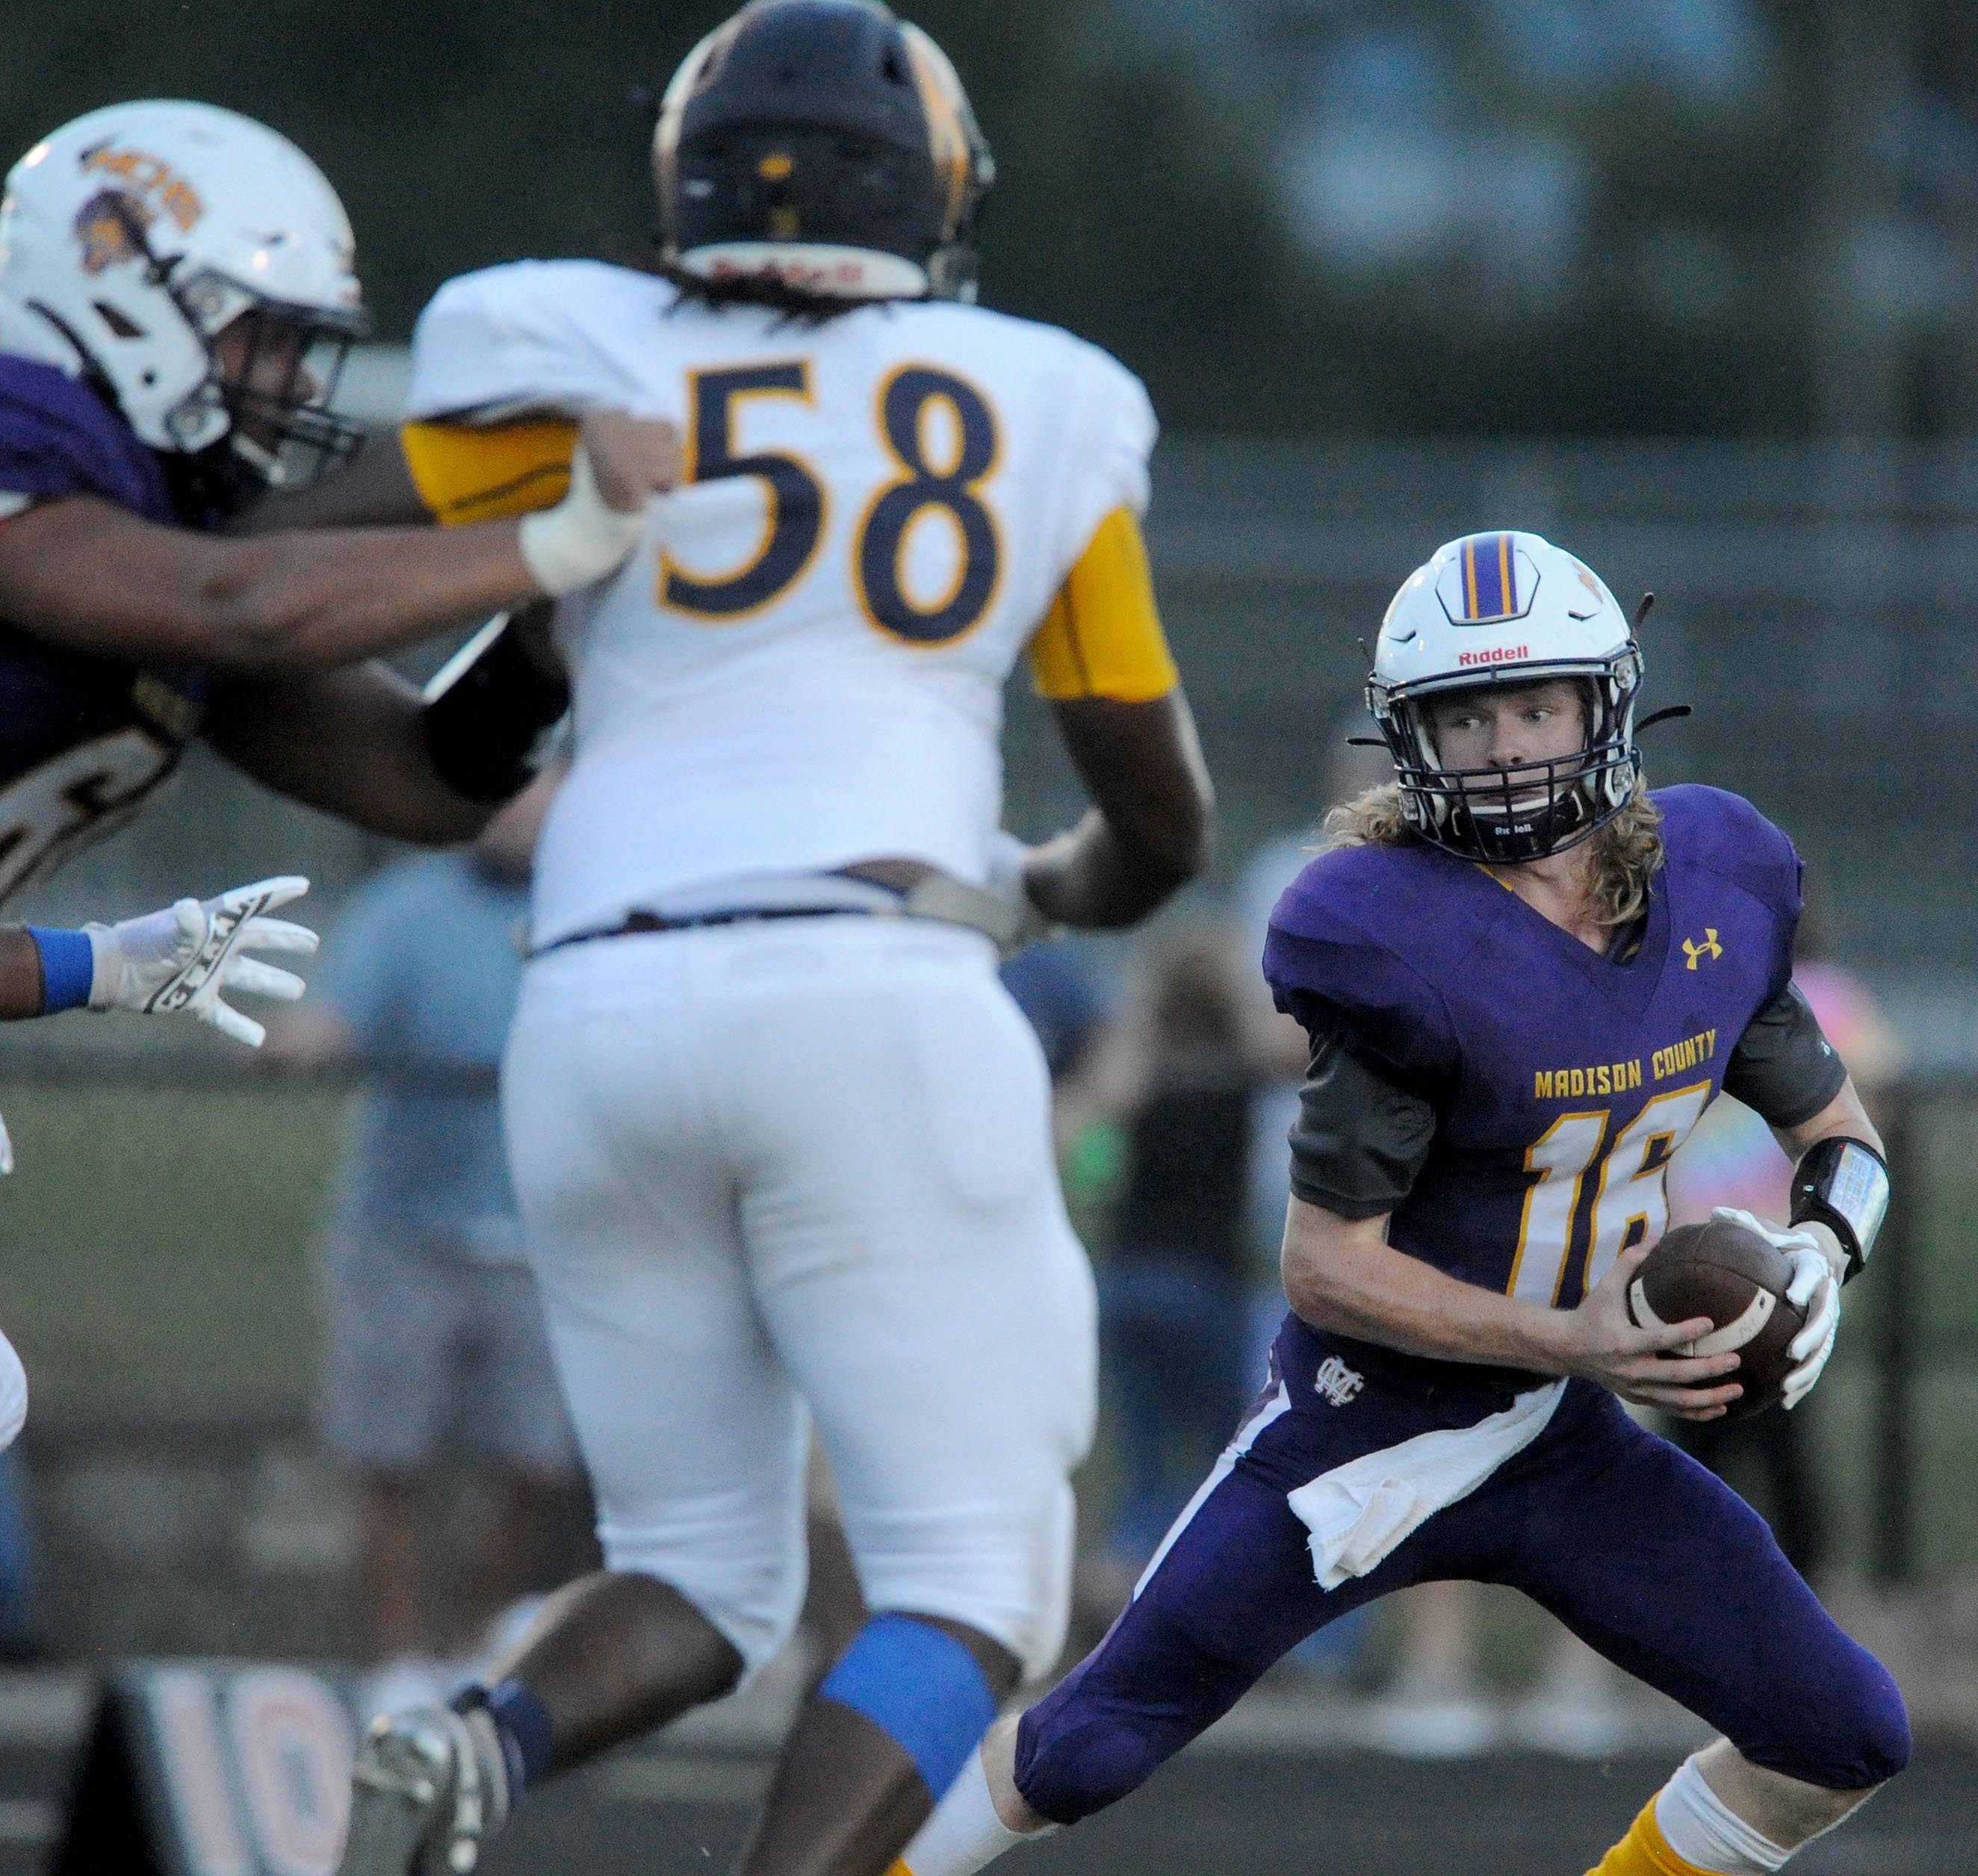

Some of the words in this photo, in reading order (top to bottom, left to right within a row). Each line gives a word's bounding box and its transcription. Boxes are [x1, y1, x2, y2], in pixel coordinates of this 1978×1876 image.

[654, 358, 1004, 648] 58
[1458, 645, 1528, 665] Riddell
[1534, 1059, 1642, 1099] MADISON
[1652, 1028, 1716, 1081] COUNTY
[1507, 1078, 1711, 1308] 16
[149, 1662, 353, 1876] 10
